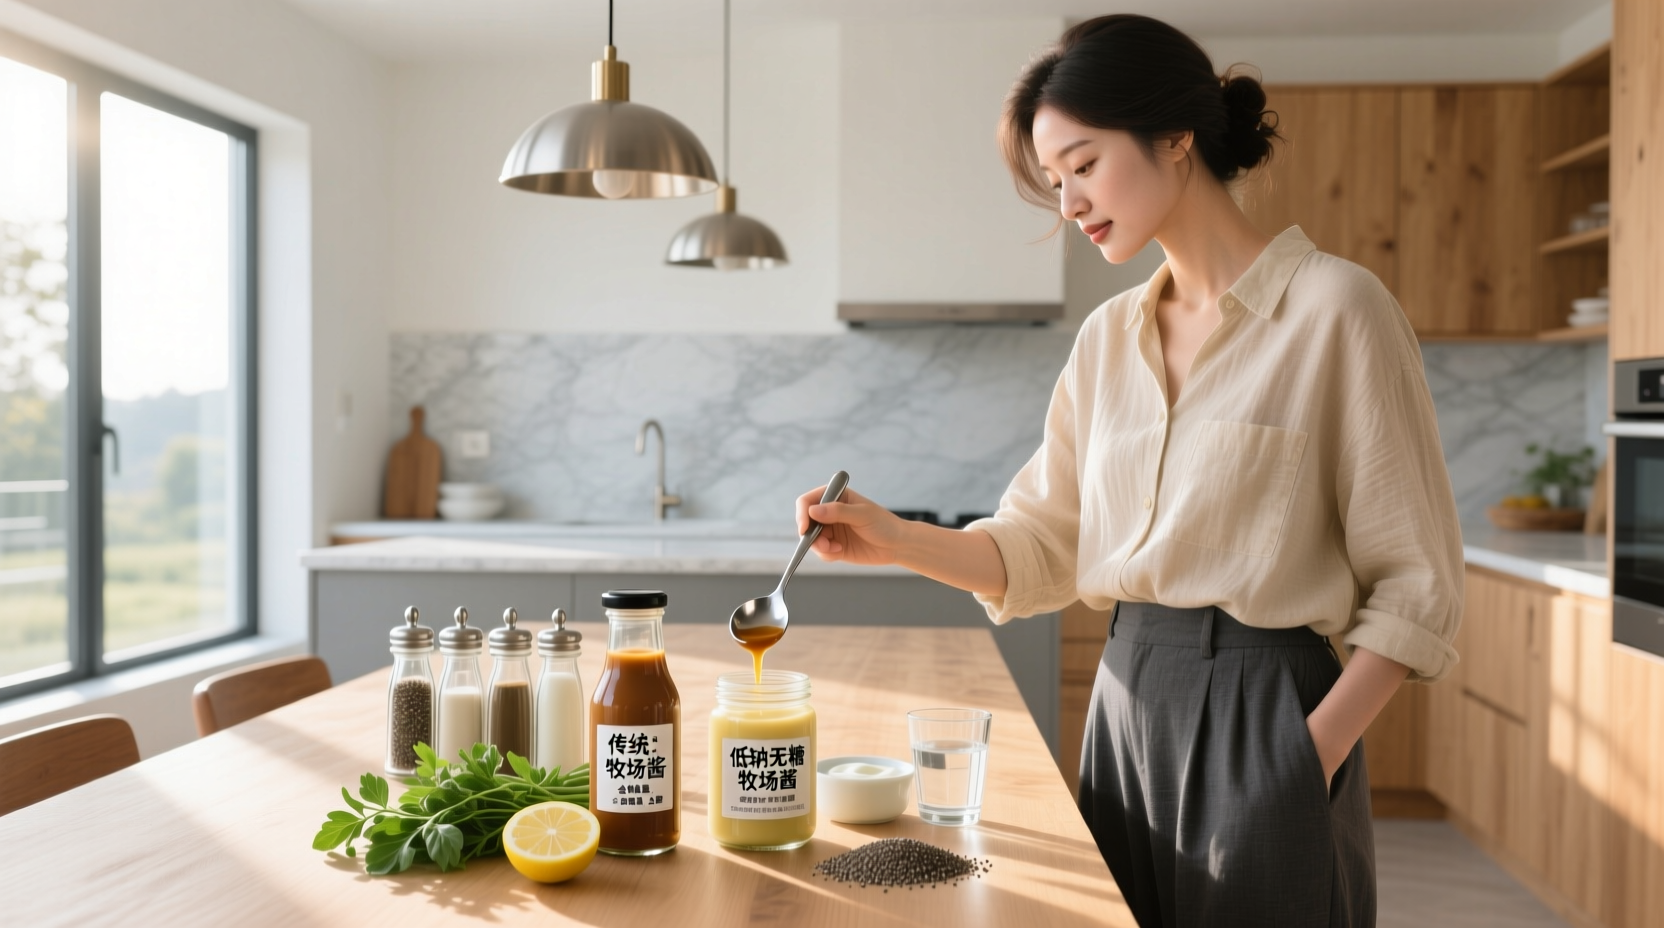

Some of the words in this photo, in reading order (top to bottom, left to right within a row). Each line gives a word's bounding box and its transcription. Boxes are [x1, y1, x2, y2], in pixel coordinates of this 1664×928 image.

[606, 756, 666, 779] 牧场酱
[738, 769, 797, 791] 牧场酱
